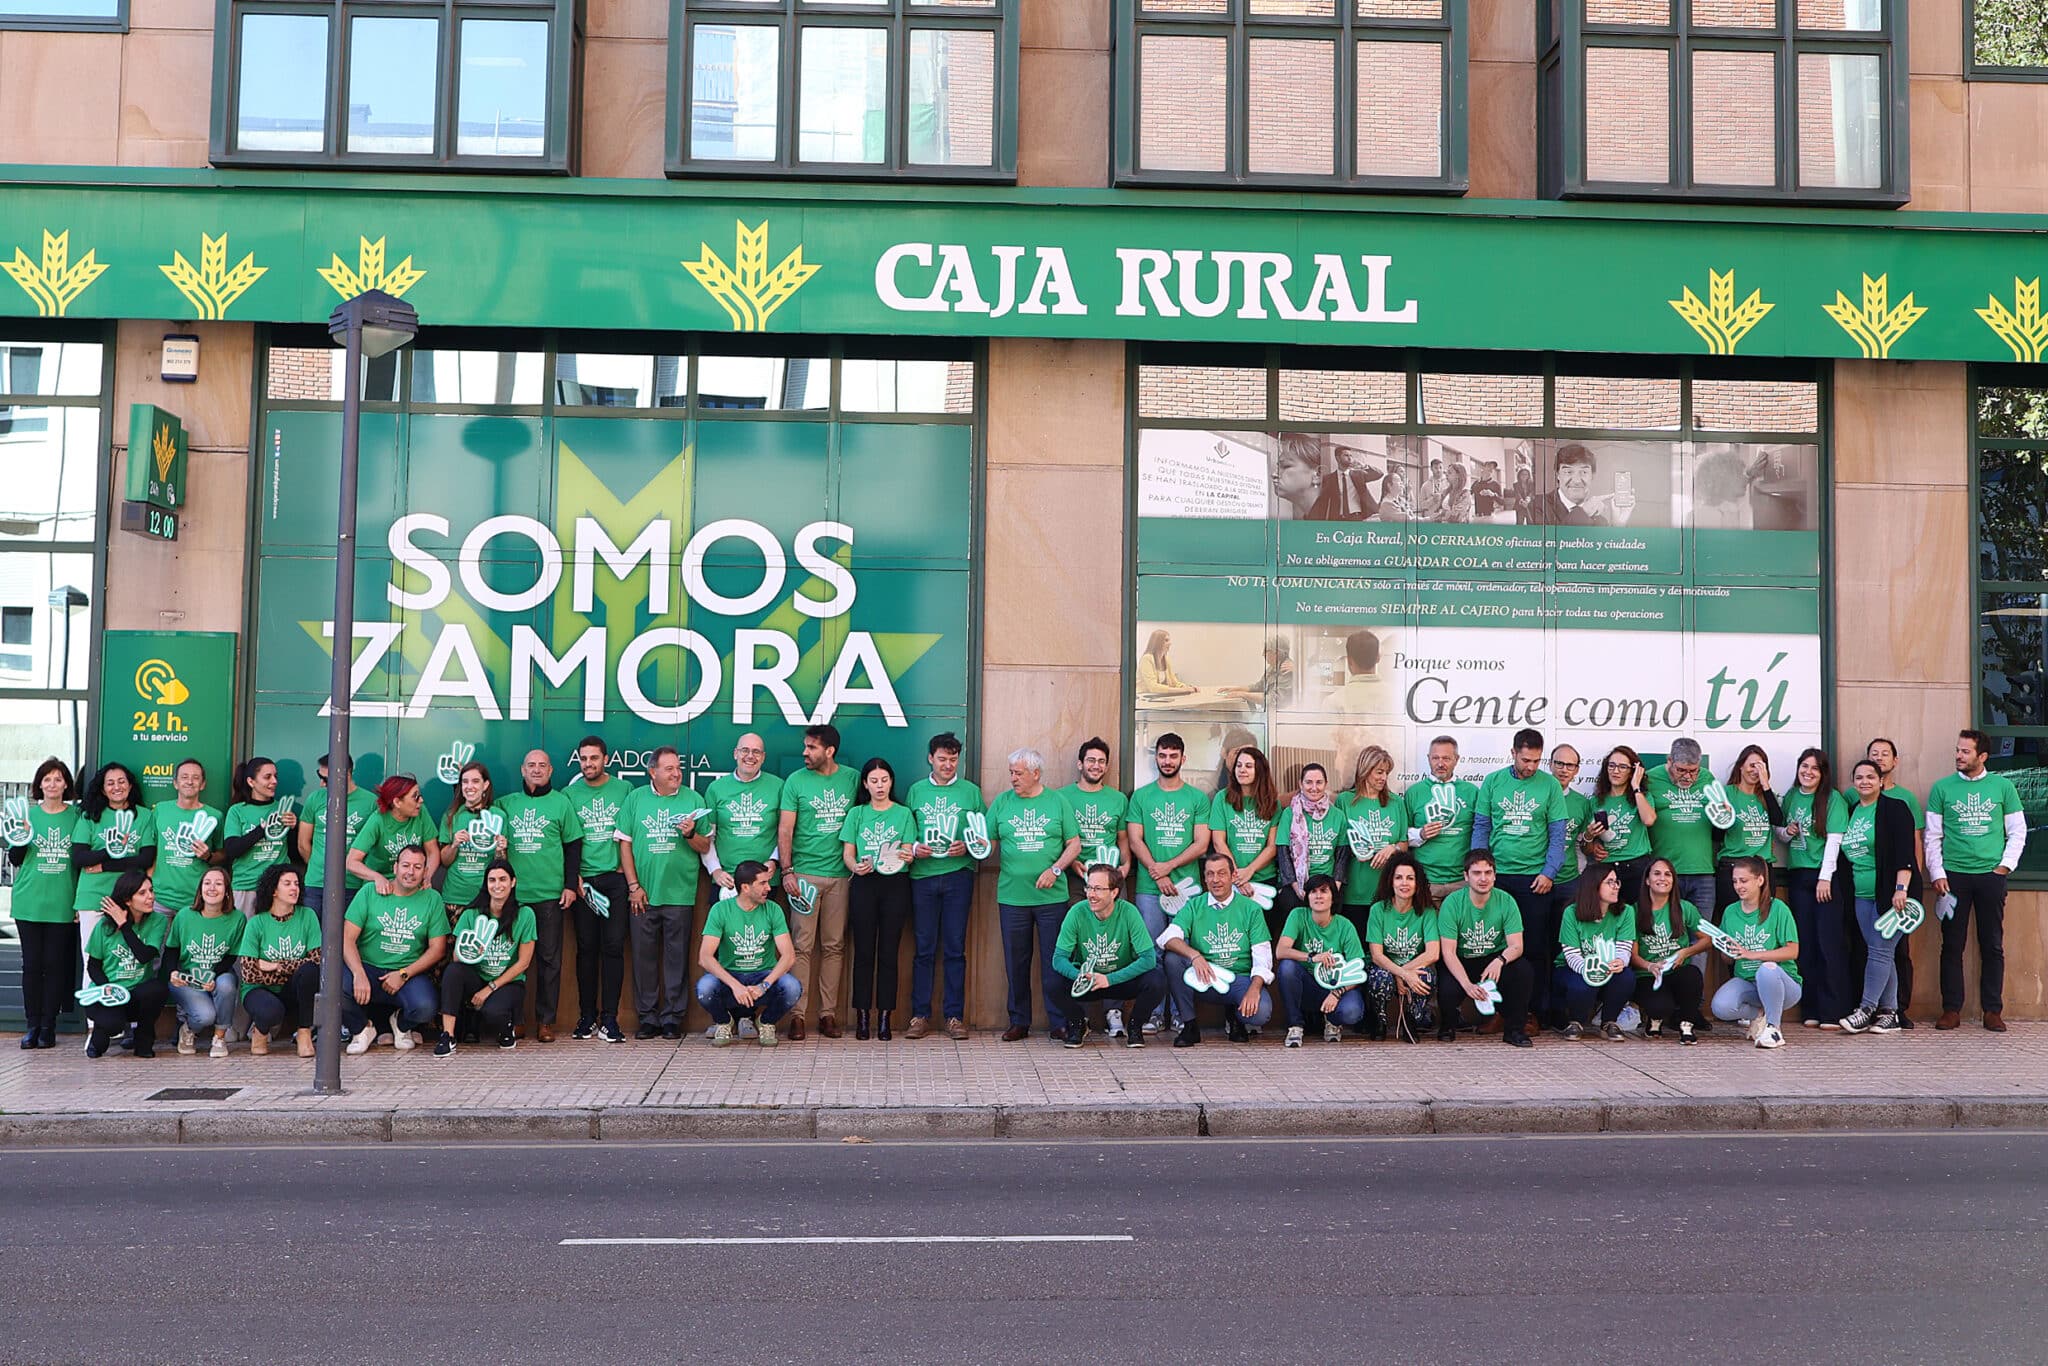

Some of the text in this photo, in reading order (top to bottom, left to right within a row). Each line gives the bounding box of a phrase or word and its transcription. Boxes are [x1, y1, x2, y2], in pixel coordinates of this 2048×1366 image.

[874, 243, 1418, 323] CAJA RURAL
[1217, 492, 1240, 500] CAPITAL
[149, 510, 161, 535] 12
[1315, 531, 1646, 550] En Caja Rural, NO CERRAMOS oficinas en pueblos y ciudades
[386, 514, 858, 619] SOMOS
[1286, 554, 1302, 564] No
[1304, 556, 1313, 565] te
[1315, 555, 1371, 568] obligaremos
[1384, 556, 1449, 567] GUARDAR
[1453, 557, 1489, 568] COLA
[1491, 560, 1503, 568] en
[1505, 558, 1514, 569] el
[1516, 558, 1552, 570] exterior
[1580, 559, 1606, 570] hacer
[1608, 560, 1649, 573] gestiones
[1227, 576, 1248, 587] NO
[1253, 577, 1268, 588] TE
[1272, 576, 1371, 589] COMUNICARÁS
[1432, 581, 1444, 591] de
[1476, 582, 1527, 594] ordenador,
[1529, 582, 1594, 595] teleoperadores
[1598, 584, 1657, 597] impersonales
[1659, 587, 1666, 597] y
[1667, 585, 1730, 597] desmotivados
[1295, 602, 1664, 620] No te enviaremos SIEMPRE AL CAJERO para hacer todas tus operaciones
[1393, 652, 1505, 676] Porque somos
[317, 621, 909, 728] ZAMORA
[1406, 651, 1792, 731] Gente como tú
[133, 711, 189, 732] 24 h.
[140, 733, 149, 741] tu
[151, 733, 188, 741] servicio
[143, 763, 174, 776] AQUÍ
[690, 754, 710, 768] LA
[1469, 756, 1504, 764] nosotros
[1397, 773, 1420, 781] trato
[1463, 773, 1484, 781] cada
[1577, 776, 1584, 785] y
